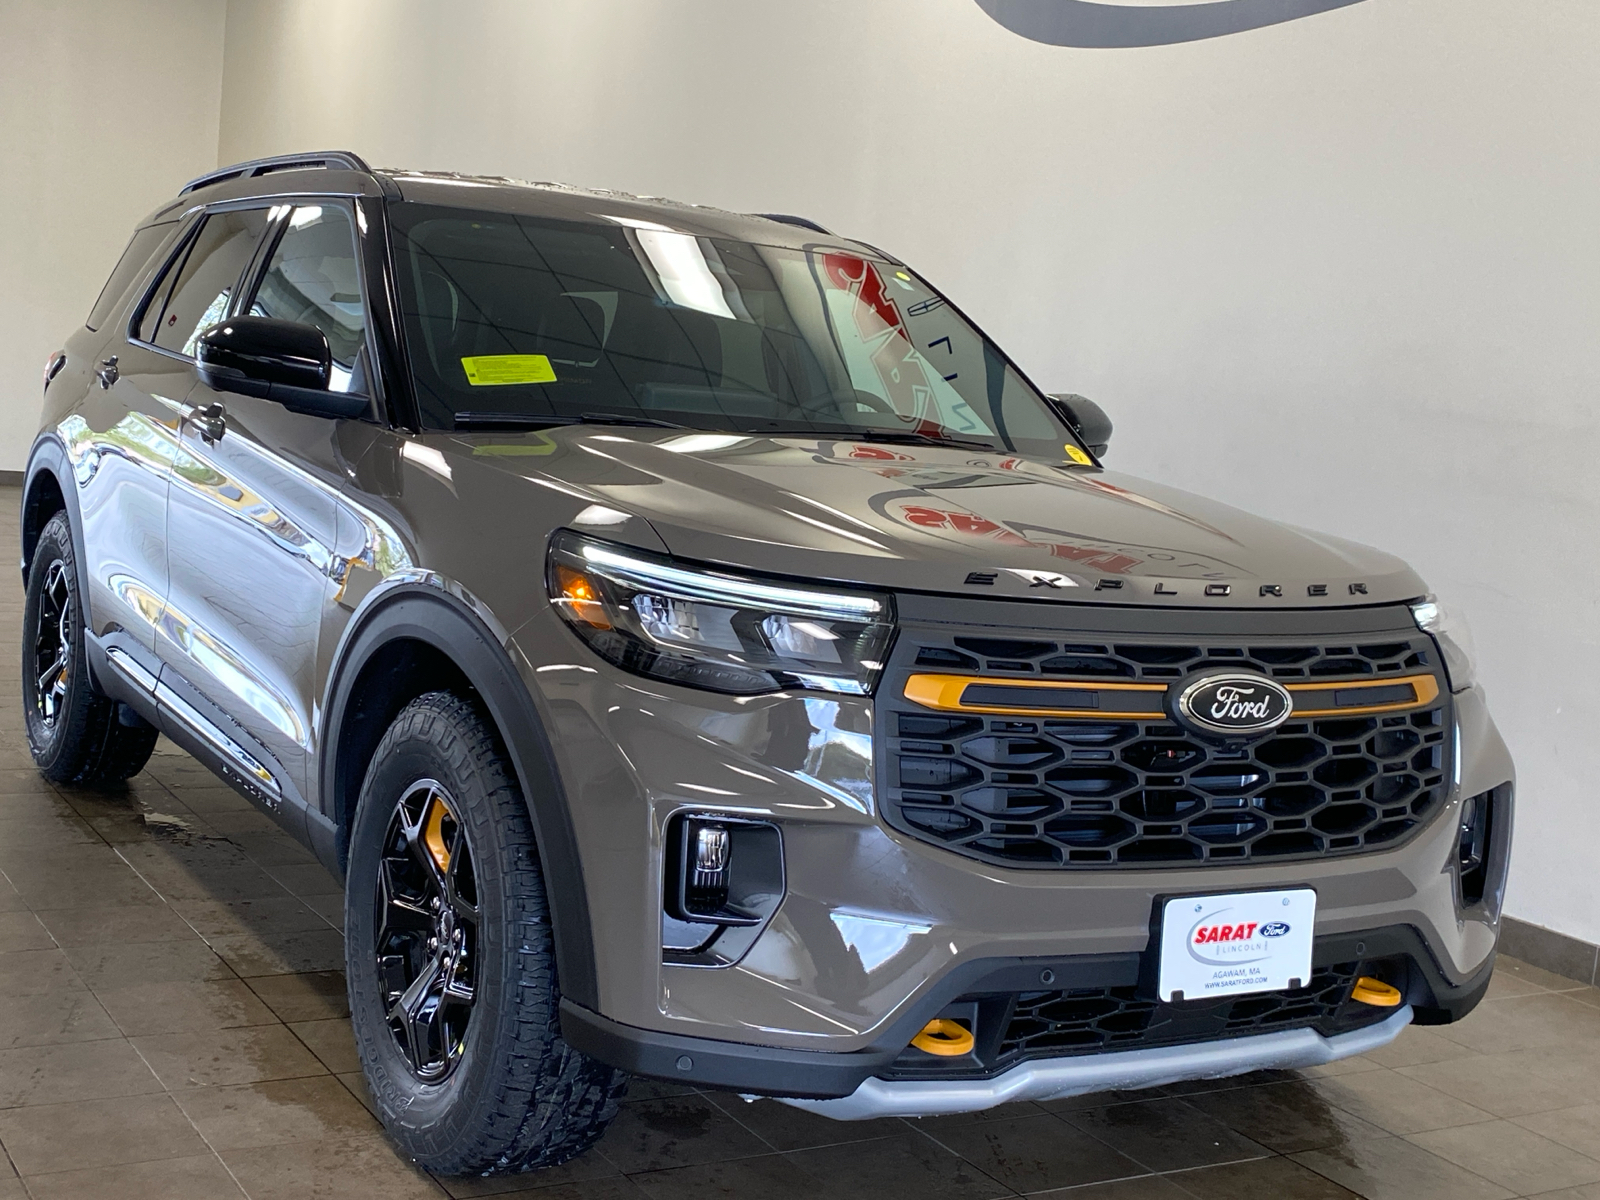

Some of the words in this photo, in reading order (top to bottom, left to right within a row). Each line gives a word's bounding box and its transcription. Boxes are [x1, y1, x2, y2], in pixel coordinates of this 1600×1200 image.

[963, 571, 1369, 598] EXPLORER
[1210, 685, 1271, 719] Ford
[1195, 923, 1258, 944] SARAT
[1263, 923, 1285, 935] Ford
[1222, 944, 1261, 953] LINCOLN
[1212, 969, 1247, 979] AGAWAM,
[1249, 967, 1261, 975] MA
[1204, 977, 1268, 989] WWW.SARATFORD.COM
